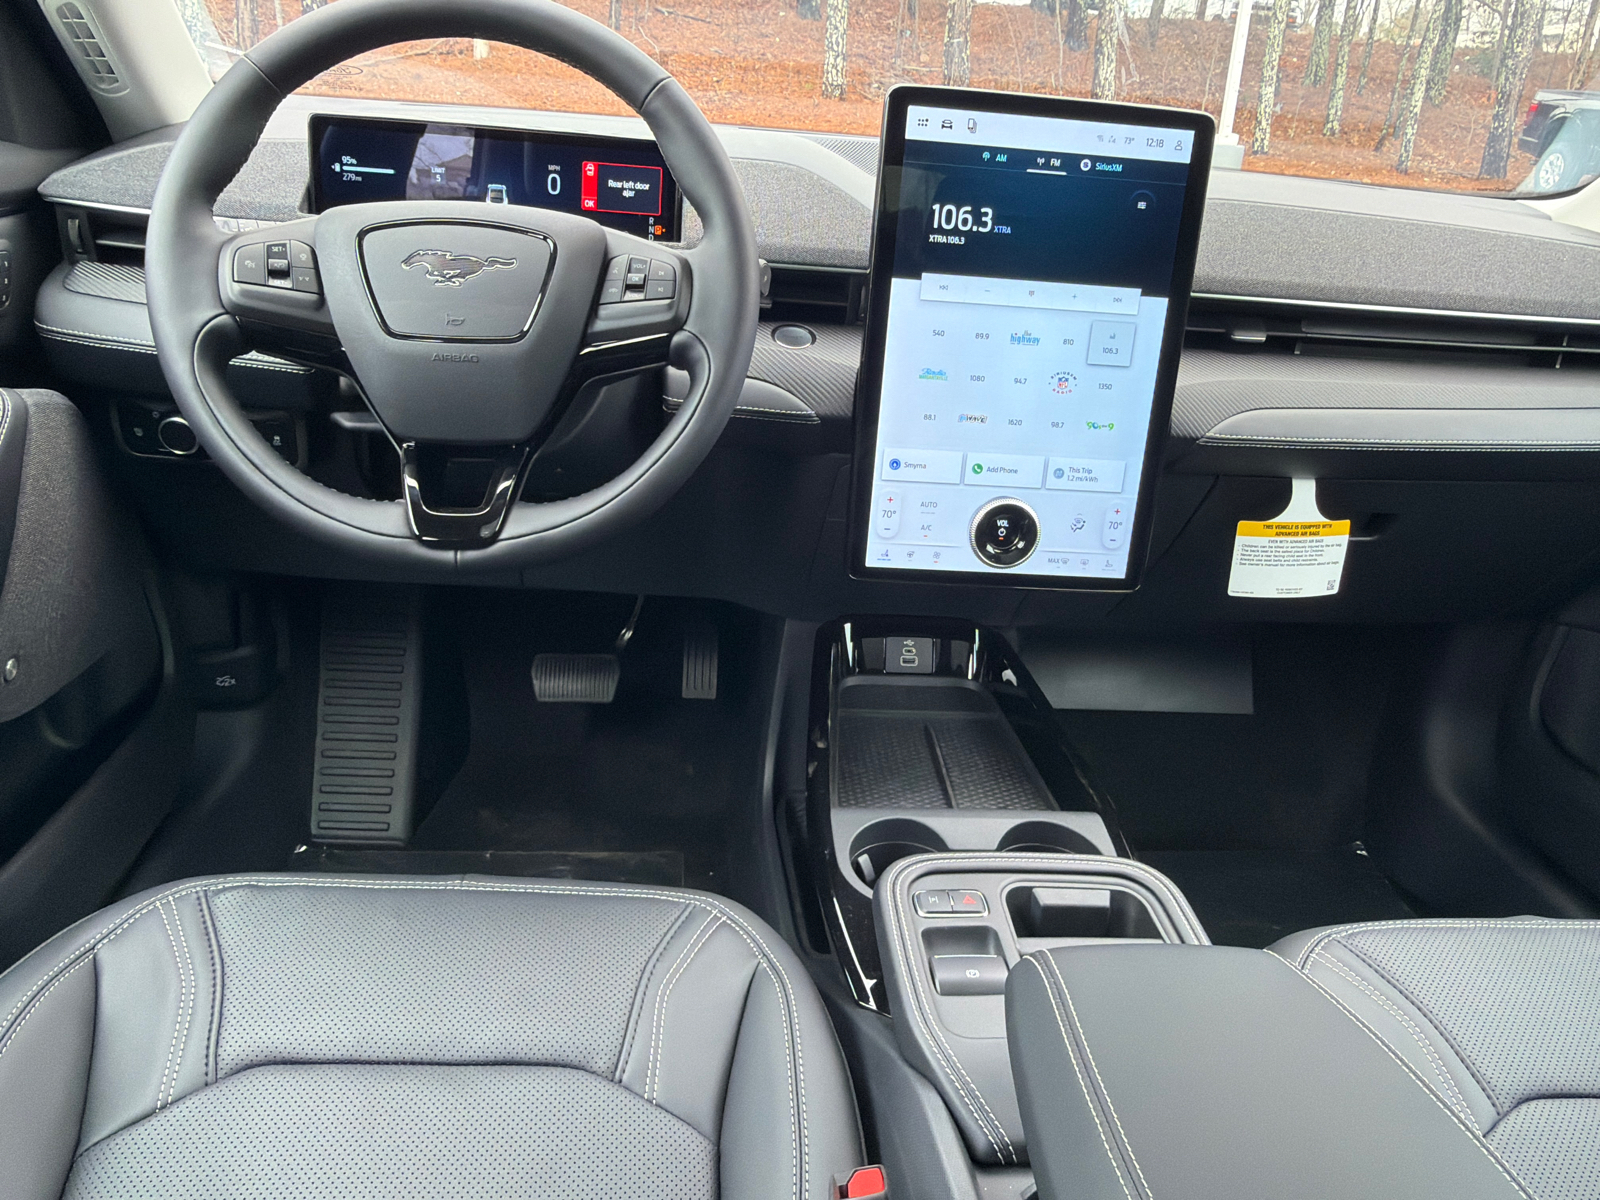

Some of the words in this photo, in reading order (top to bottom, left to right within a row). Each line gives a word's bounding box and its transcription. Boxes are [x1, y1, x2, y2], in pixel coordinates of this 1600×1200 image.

[1146, 137, 1165, 148] 12:18
[341, 155, 358, 165] 95%
[995, 153, 1008, 163] AM
[1050, 158, 1061, 167] FM
[1095, 162, 1123, 173] SiriusXM
[435, 174, 442, 182] 5
[547, 173, 561, 195] 0
[608, 179, 623, 189] Rear
[623, 180, 635, 190] left
[635, 182, 650, 191] door
[622, 188, 636, 198] ajar
[584, 199, 595, 208] OK
[648, 217, 655, 225] R
[932, 203, 993, 233] 106.3
[993, 225, 1012, 234] XTRA
[928, 234, 947, 244] XTRA
[947, 236, 966, 245] 106.3
[932, 329, 945, 337] 540
[975, 332, 990, 340] 89.9
[1010, 332, 1041, 346] highway
[1062, 338, 1075, 346] 810
[1102, 346, 1119, 355] 106.3
[431, 352, 480, 364] AIRBAG
[969, 374, 986, 382] 1080
[1013, 377, 1028, 385] 94.7
[1098, 382, 1113, 391] 1350
[923, 413, 937, 421] 88.1
[1050, 421, 1065, 429] 98.7
[903, 461, 927, 470] Smyrna
[986, 466, 999, 474] Add
[999, 467, 1019, 475] Phone
[1068, 466, 1081, 474] This
[1082, 467, 1093, 475] Trip
[882, 509, 897, 519] 70°
[996, 519, 1010, 527] VOL
[1108, 520, 1123, 530] 70°
[920, 524, 932, 532] A/C
